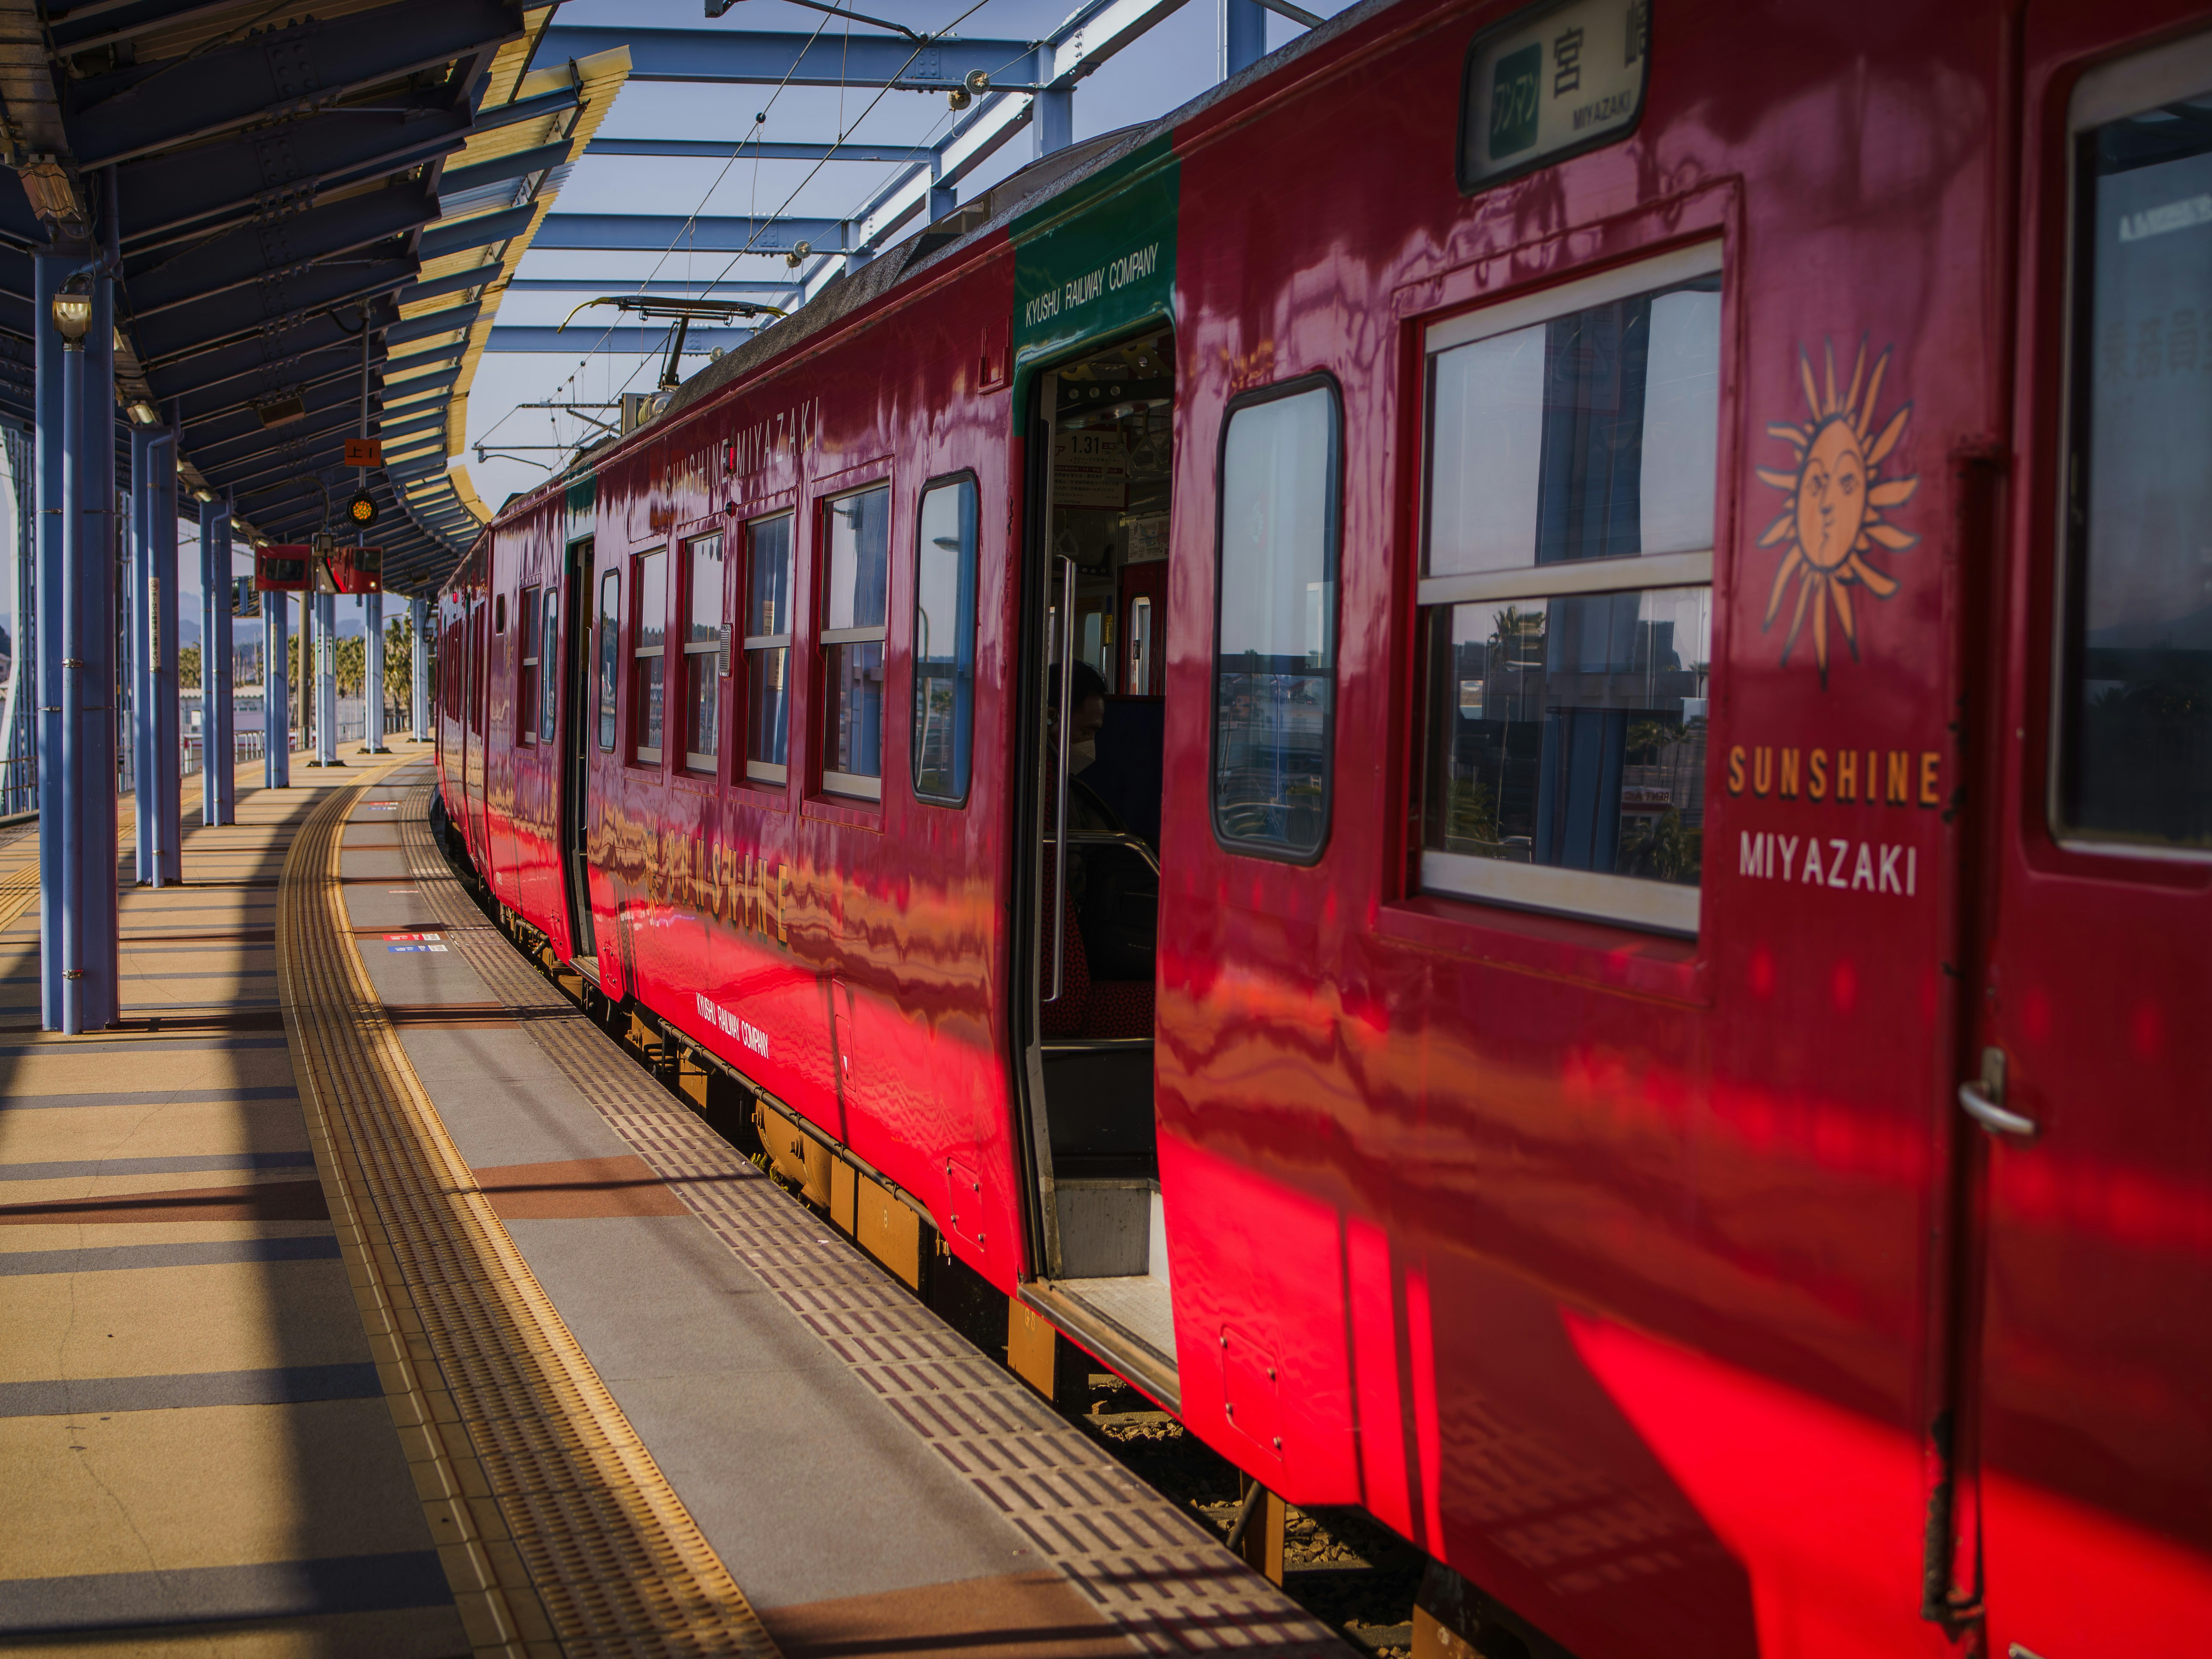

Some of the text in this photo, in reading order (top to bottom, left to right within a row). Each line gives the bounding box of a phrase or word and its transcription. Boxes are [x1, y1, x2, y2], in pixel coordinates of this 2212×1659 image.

[1494, 71, 1539, 136] ワンマン
[1573, 89, 1631, 131] MIYAZAKI
[1026, 242, 1158, 327] KYUSHU RAILWAY COMPANY
[666, 396, 819, 506] SUNSHINE MIYAZAKI
[1071, 436, 1099, 454] 1.31
[1728, 744, 1941, 806] SUNSHINE
[666, 828, 788, 947] SUNSHINE
[1740, 830, 1917, 897] MIYAZAKI
[696, 992, 769, 1059] KYUSHU RAILWAY COMPANY
